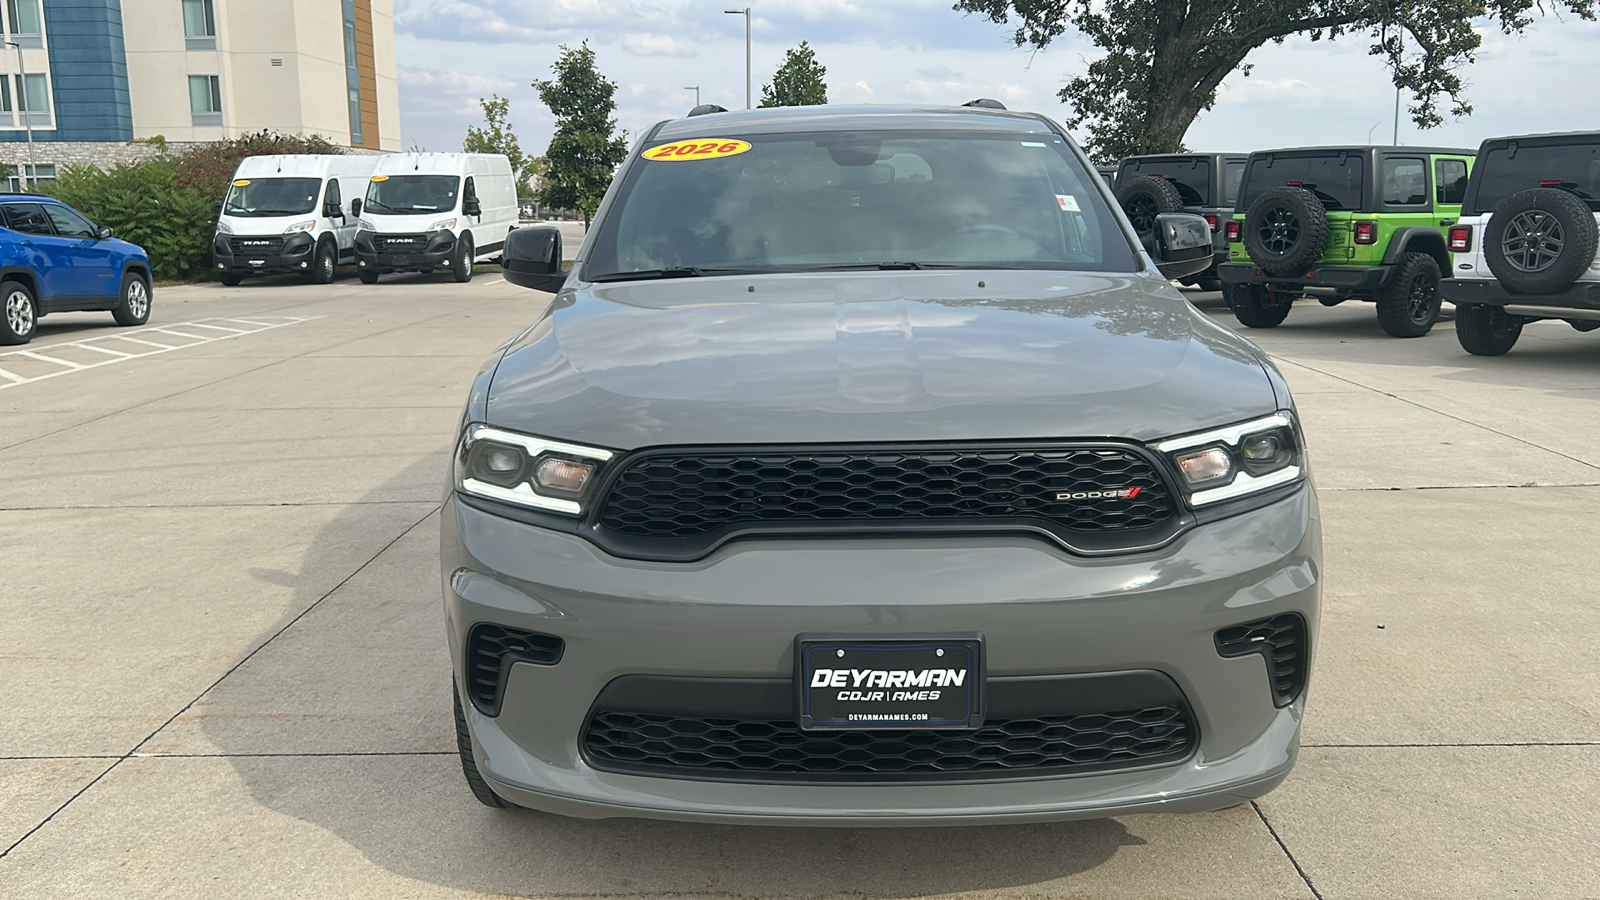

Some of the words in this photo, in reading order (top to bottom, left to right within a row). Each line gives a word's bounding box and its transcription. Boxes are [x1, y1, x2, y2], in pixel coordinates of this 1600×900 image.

[653, 142, 740, 157] 2026
[1056, 489, 1131, 500] DODGE
[811, 669, 966, 688] DEYARMAN
[892, 690, 941, 701] AMES
[848, 713, 928, 721] DEYARMANAMES.COM
